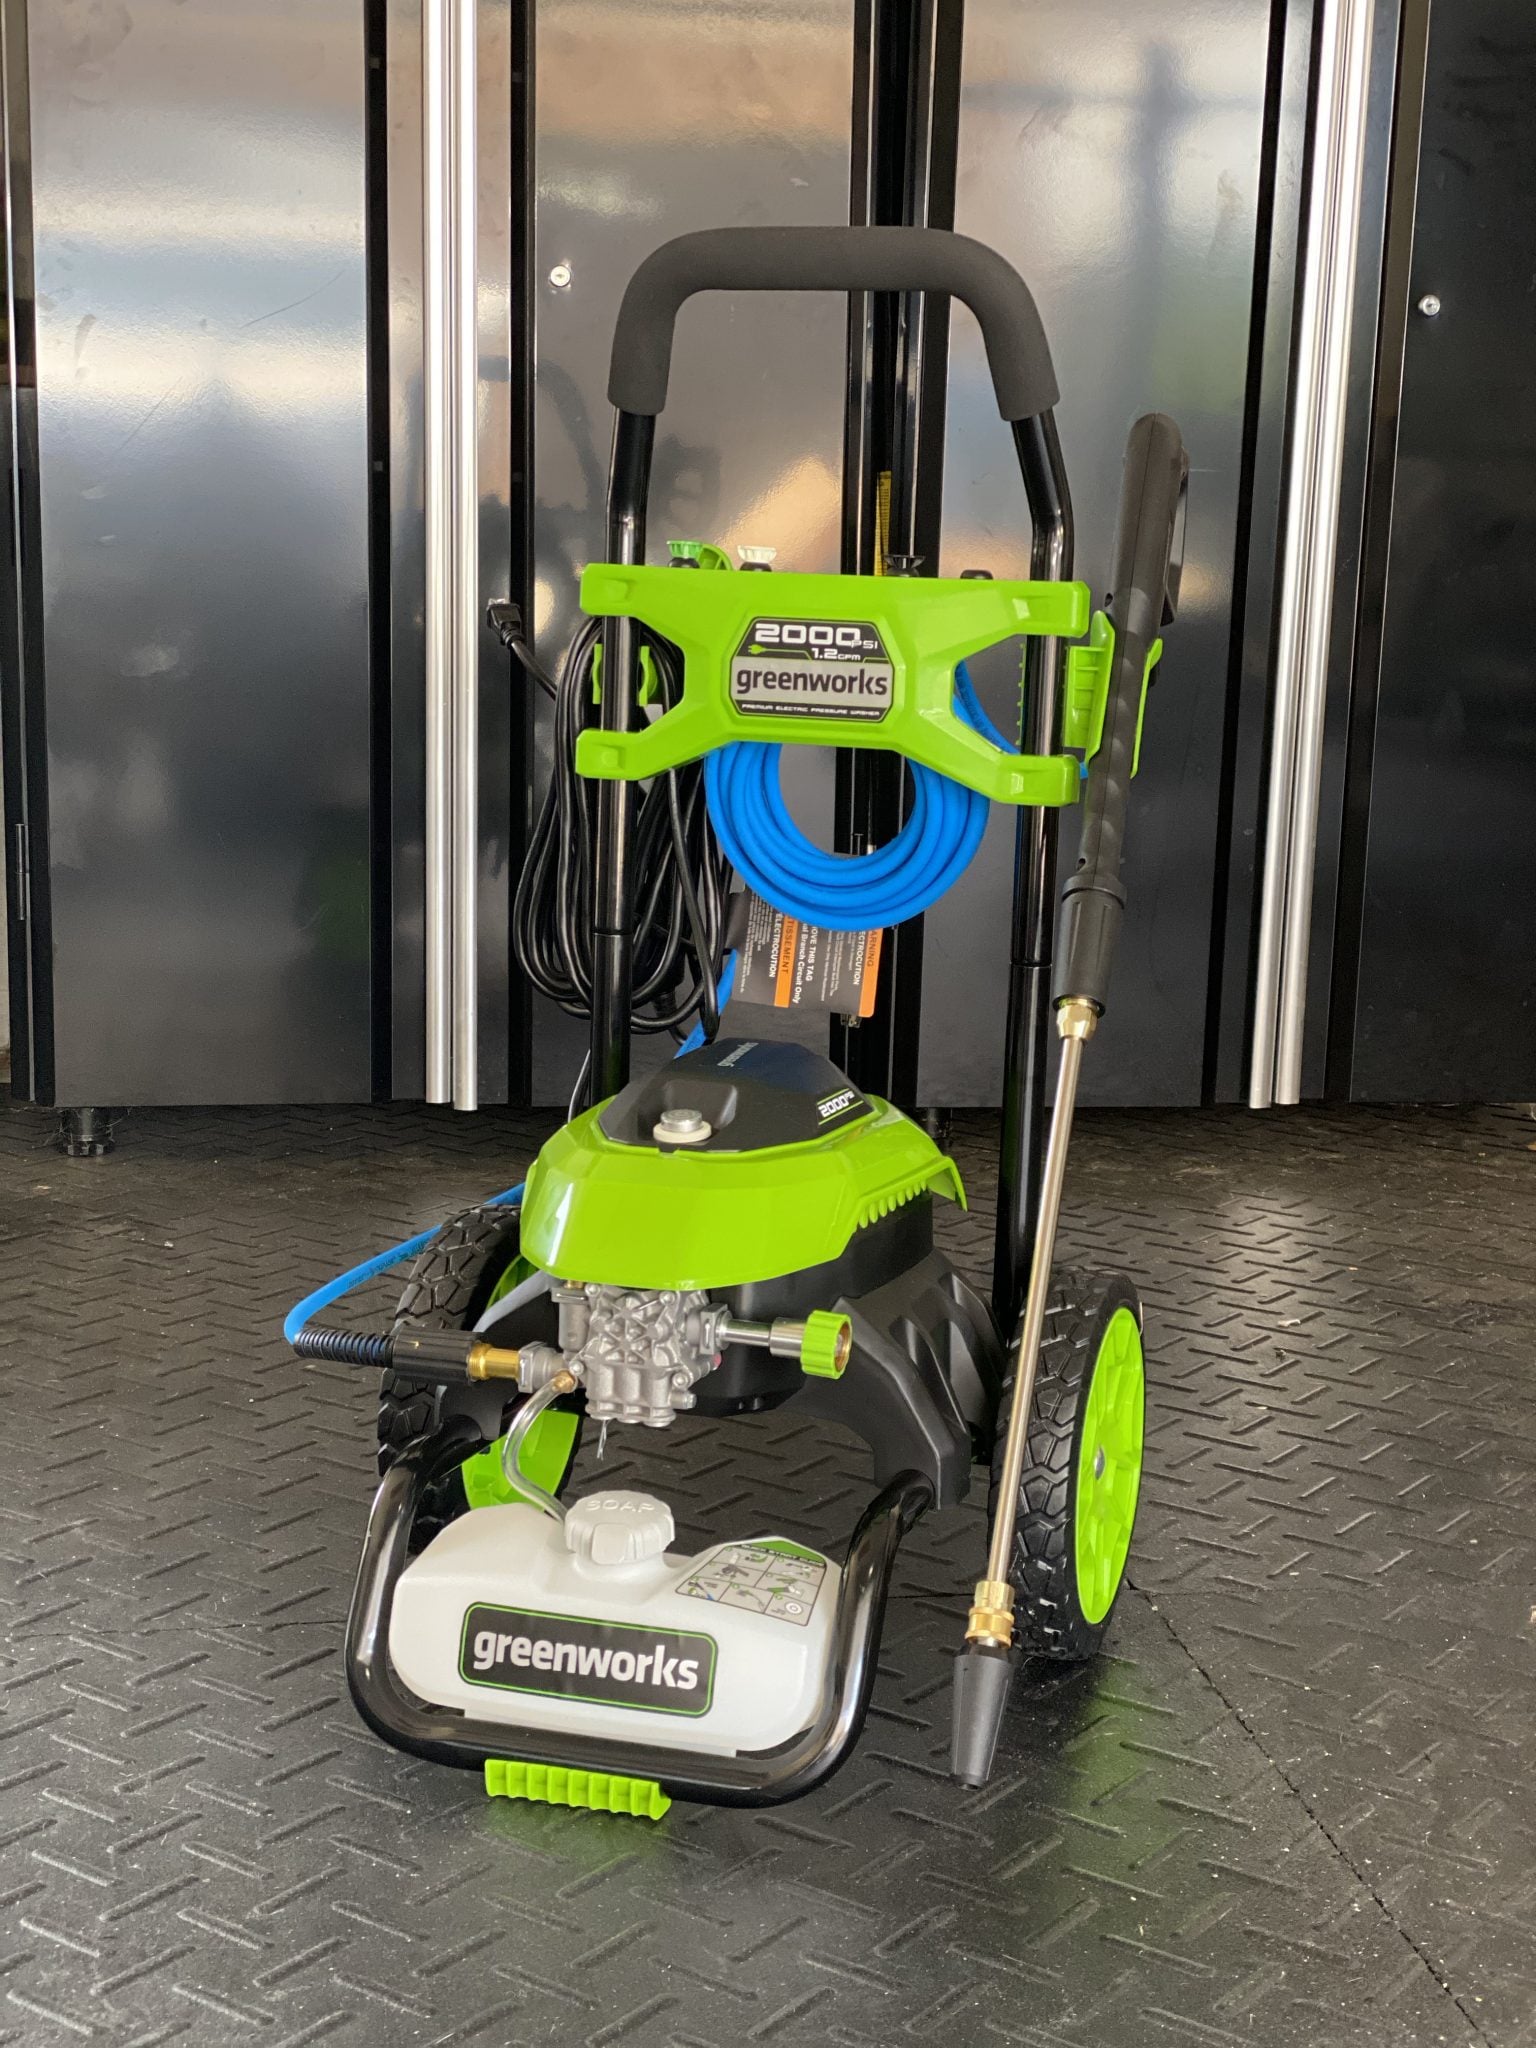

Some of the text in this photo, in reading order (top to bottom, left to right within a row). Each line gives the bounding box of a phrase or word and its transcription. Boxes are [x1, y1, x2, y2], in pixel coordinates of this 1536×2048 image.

[755, 623, 861, 646] 2000
[811, 647, 838, 660] 1.2
[737, 668, 888, 696] greenworks
[741, 703, 774, 711] PREMIUM
[798, 936, 809, 961] Branch
[807, 946, 817, 964] THIS
[795, 961, 805, 987] Circuit
[805, 965, 814, 982] TAG
[792, 987, 803, 1004] Only
[817, 1096, 849, 1118] 2000
[585, 1499, 655, 1513] SOAP
[473, 1630, 699, 1690] greenworks
